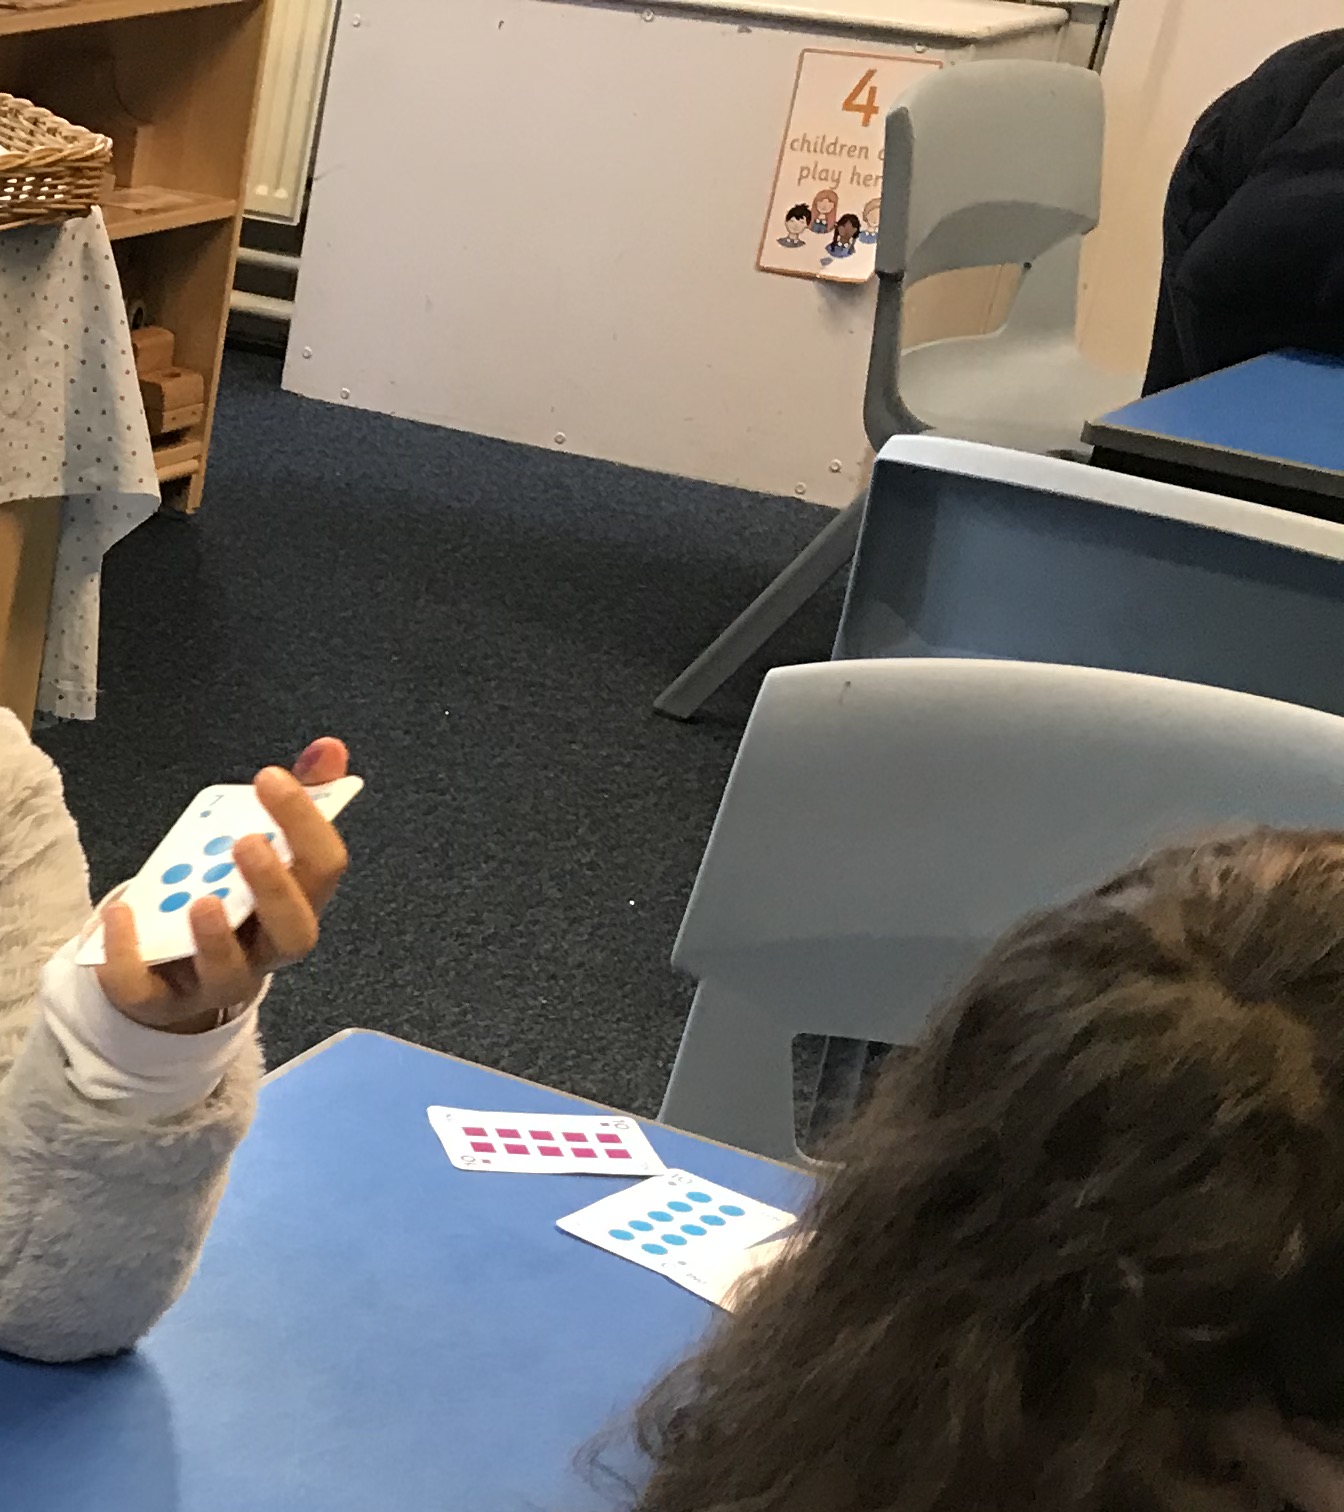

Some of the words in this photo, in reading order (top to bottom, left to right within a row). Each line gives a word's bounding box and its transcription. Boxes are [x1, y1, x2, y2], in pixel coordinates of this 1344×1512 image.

[842, 68, 879, 127] 4
[790, 133, 870, 160] children
[797, 162, 842, 190] play
[850, 165, 883, 188] her
